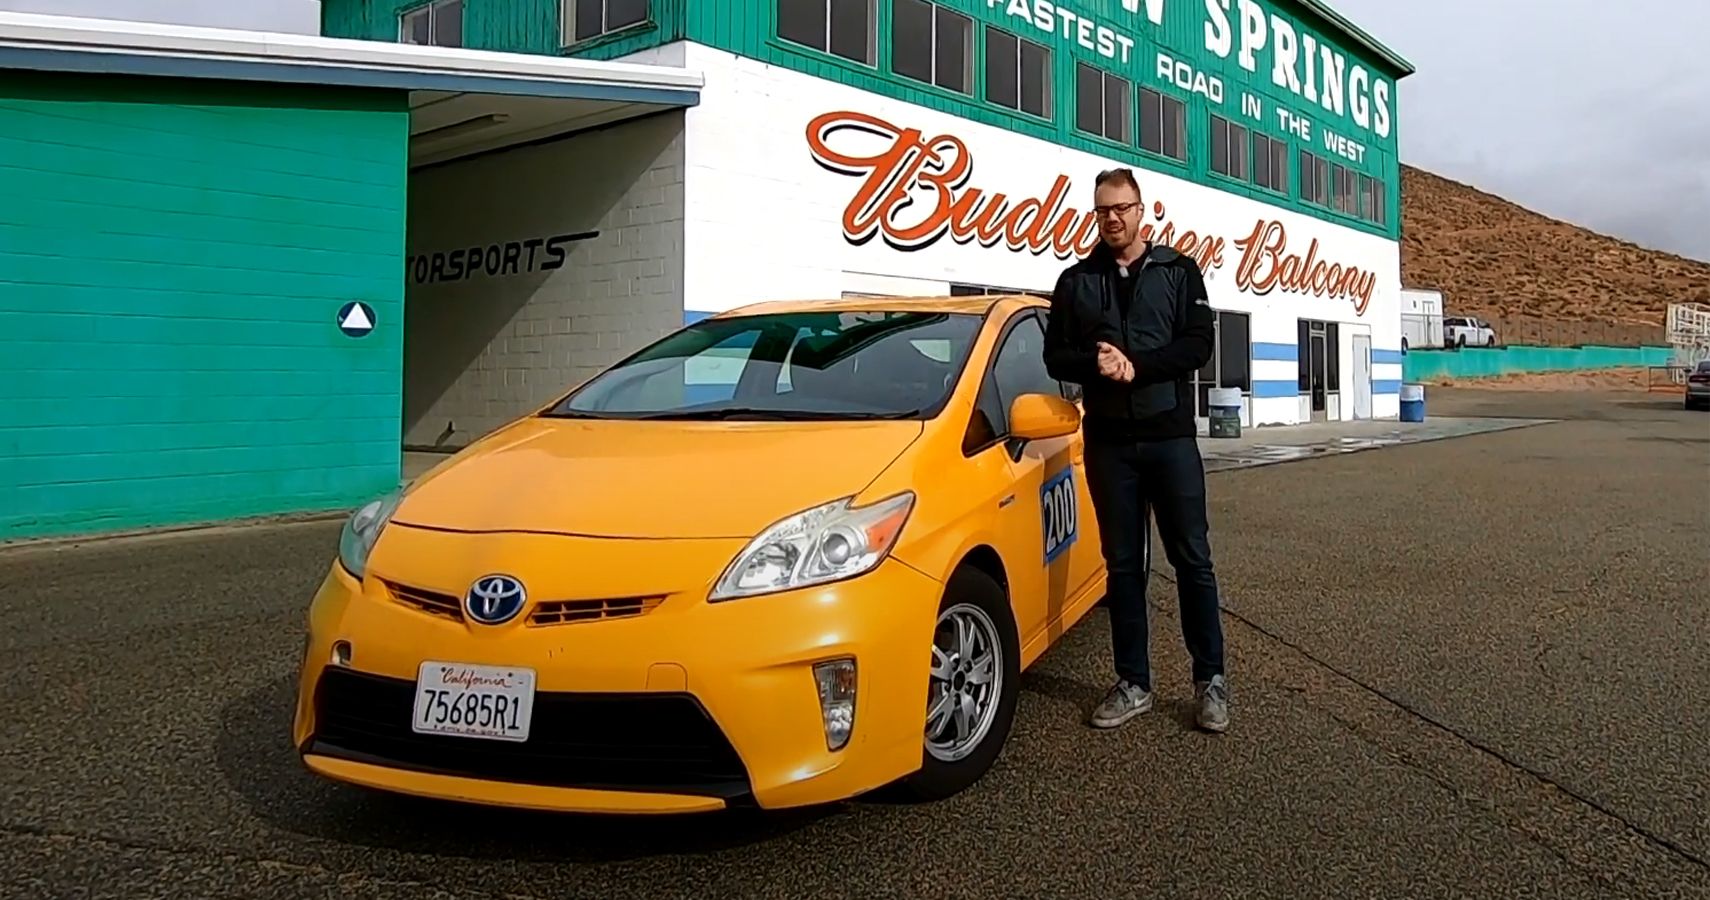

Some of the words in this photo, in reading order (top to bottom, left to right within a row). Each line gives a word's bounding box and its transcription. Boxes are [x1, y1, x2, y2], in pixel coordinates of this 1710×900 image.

[1156, 53, 1224, 104] ROAD
[1241, 92, 1262, 121] IN
[1276, 107, 1311, 142] THE
[1323, 129, 1365, 164] WEST
[1204, 0, 1391, 138] SPRINGS
[805, 111, 1224, 275] Budwiser
[1234, 219, 1377, 317] Balcony
[1043, 477, 1074, 554] 200
[424, 689, 520, 730] 75685R1
[442, 667, 512, 690] California
